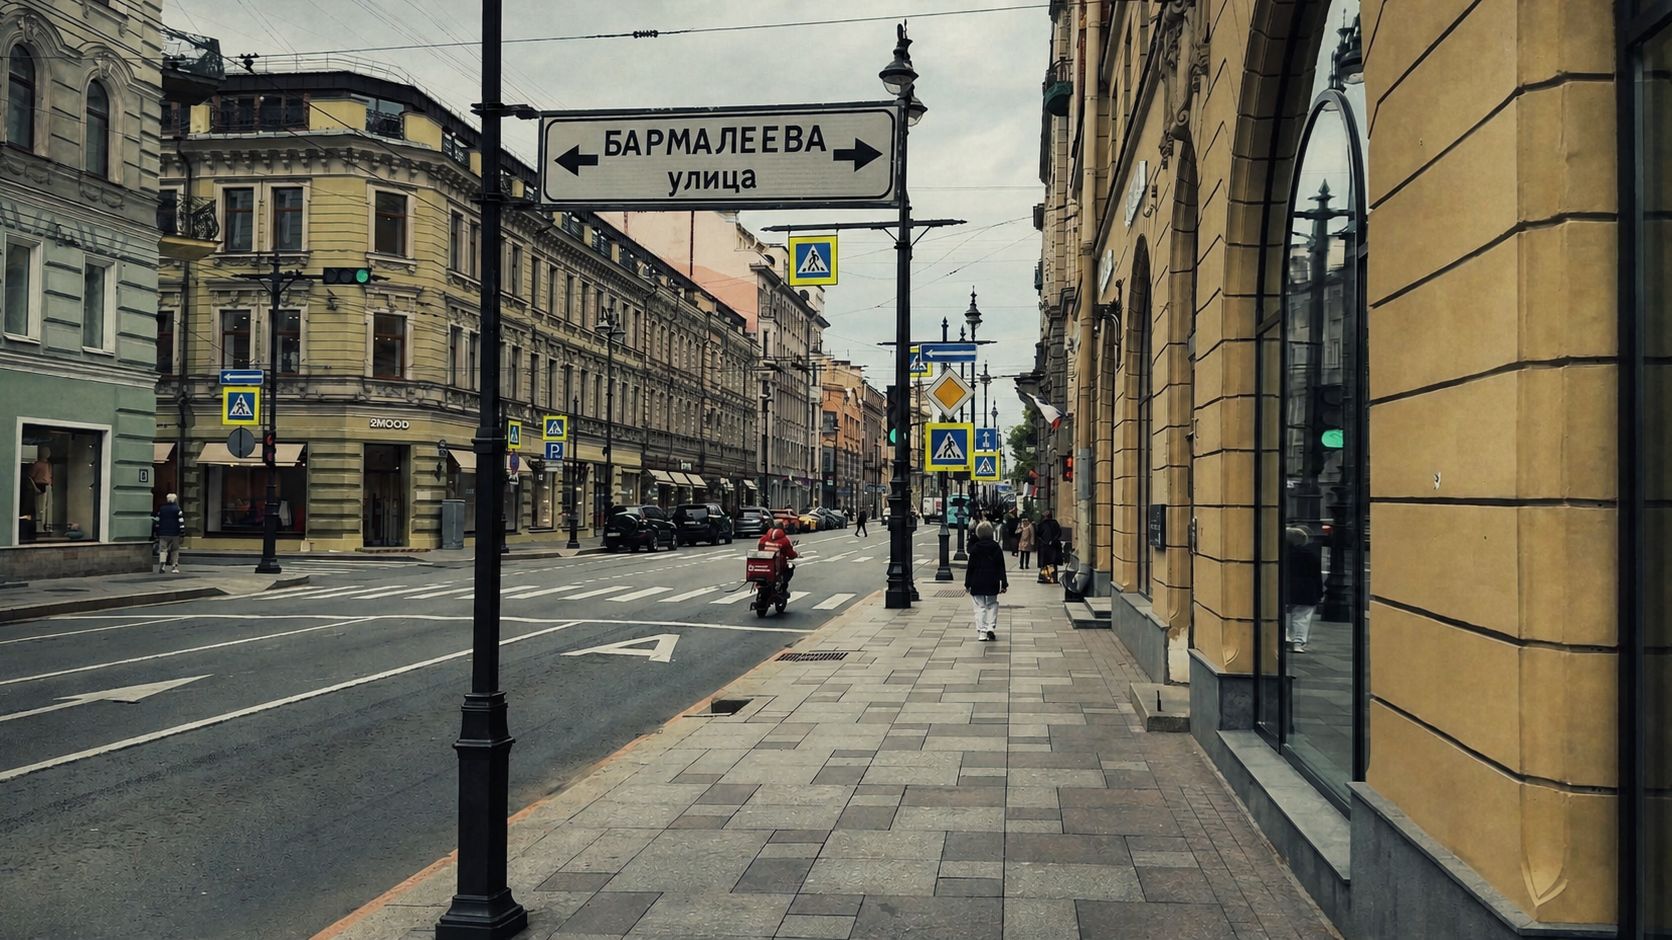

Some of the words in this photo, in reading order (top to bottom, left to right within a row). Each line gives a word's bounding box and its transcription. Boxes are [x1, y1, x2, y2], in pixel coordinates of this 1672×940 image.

[604, 125, 827, 156] БАРМАЛЕЕВА
[668, 168, 757, 197] улица
[370, 418, 410, 430] 2MOOD
[550, 443, 560, 459] P
